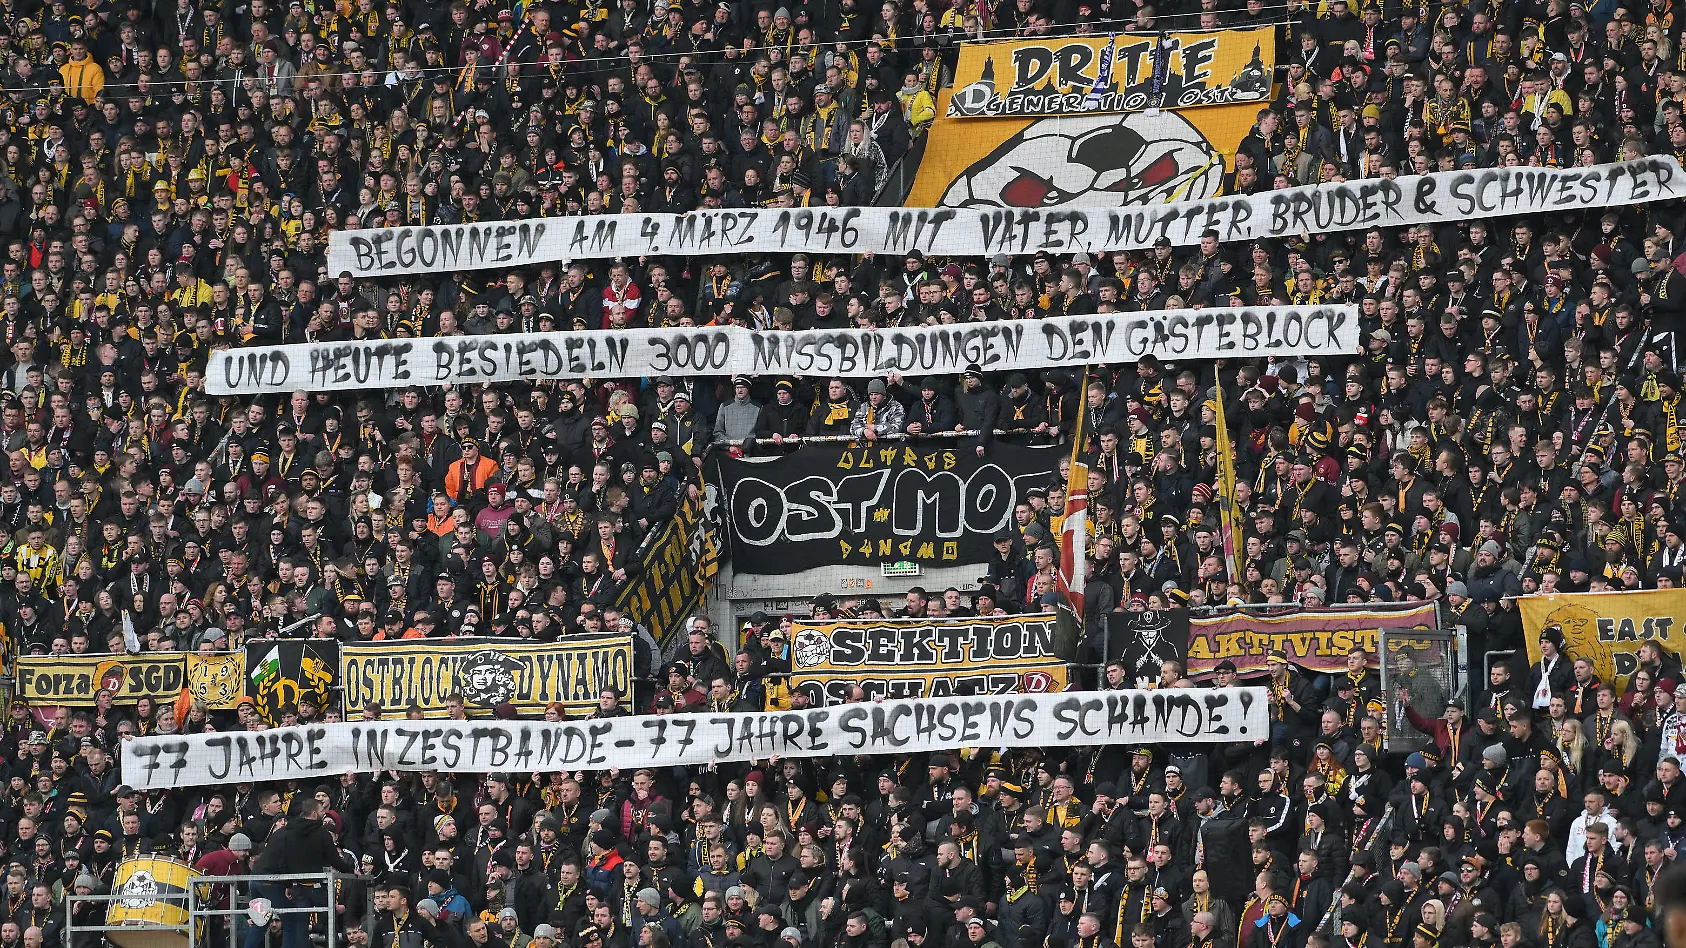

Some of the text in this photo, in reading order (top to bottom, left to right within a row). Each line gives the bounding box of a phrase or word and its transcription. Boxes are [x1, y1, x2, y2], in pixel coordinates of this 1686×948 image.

[349, 222, 547, 271] BEGONNEN
[568, 219, 618, 253] AM
[668, 211, 759, 250] MÄRZ
[772, 208, 861, 248] 1946
[883, 210, 956, 251] MIT
[980, 210, 1091, 253] VATER,
[1106, 199, 1252, 245] MUTTER,
[1414, 177, 1442, 216] &
[1450, 159, 1675, 214] SCHWESTER
[223, 309, 1346, 388] UND HEUTE BESIEDELN 3000 MISSBILDUNGEN DEN GÄSTEBLOCK
[829, 622, 1056, 668] SEKTION
[1596, 616, 1675, 643] EAST
[19, 667, 92, 697] Forza
[128, 664, 183, 696] SGD
[516, 647, 628, 704] DYNAMO
[131, 741, 190, 786] 77
[204, 728, 329, 780] JAHRE
[710, 711, 830, 758] JAHRE
[839, 694, 1036, 748] SACHSENS
